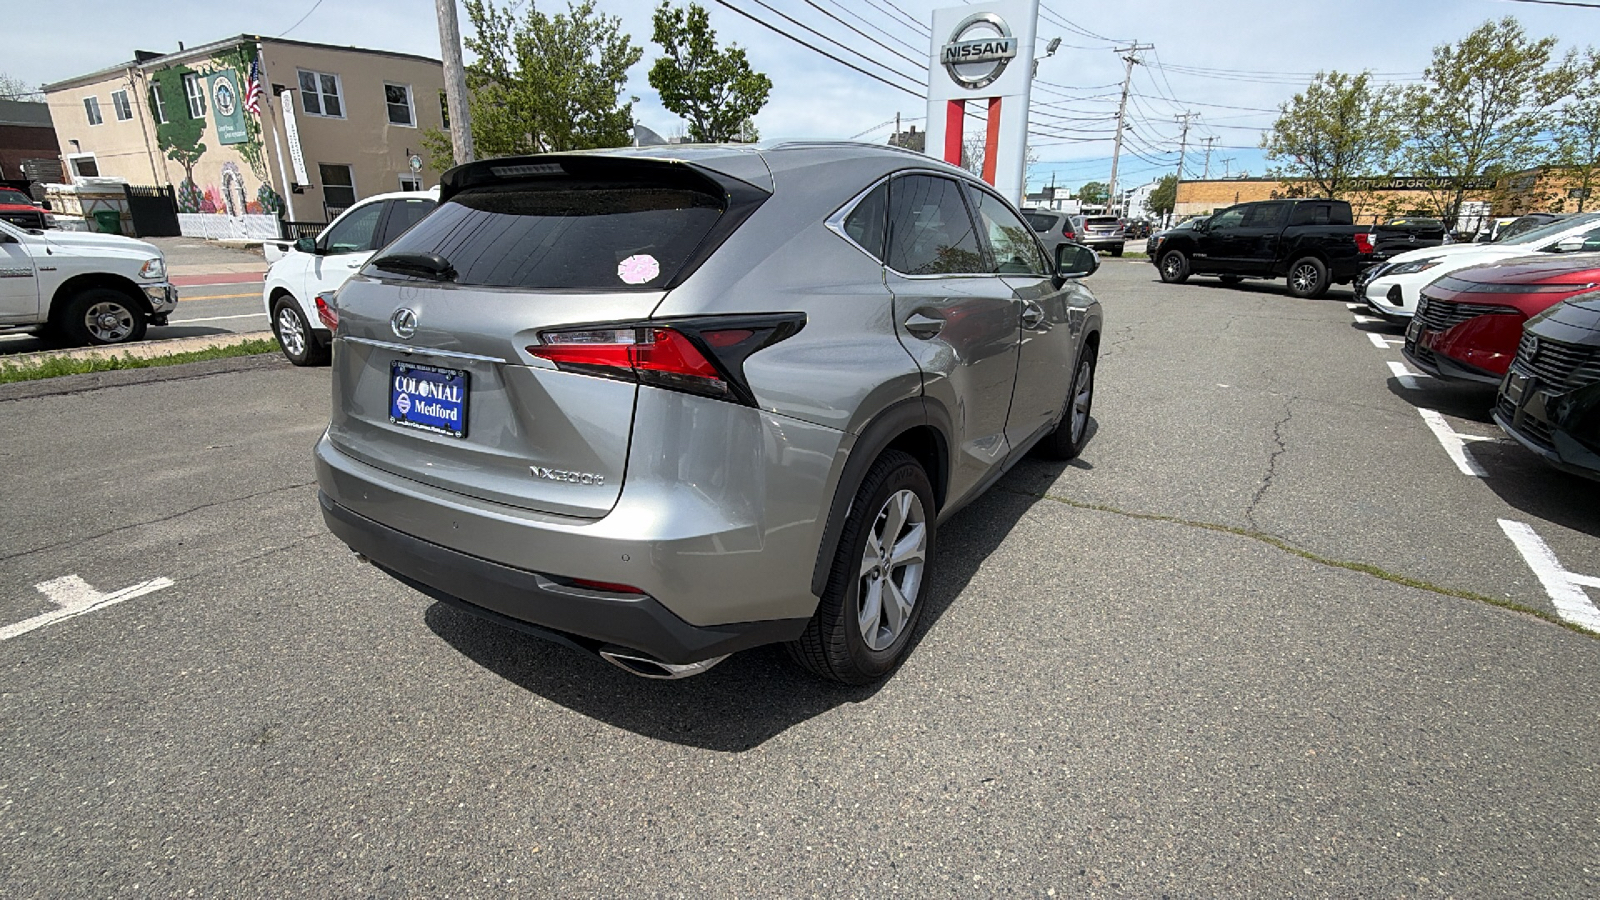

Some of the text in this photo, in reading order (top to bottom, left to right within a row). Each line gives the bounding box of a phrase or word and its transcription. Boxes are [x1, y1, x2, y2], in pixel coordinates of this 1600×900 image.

[946, 42, 1009, 59] NISSAN
[1406, 178, 1452, 189] GROUP
[395, 375, 461, 403] COLONIAL
[414, 399, 458, 421] Medford
